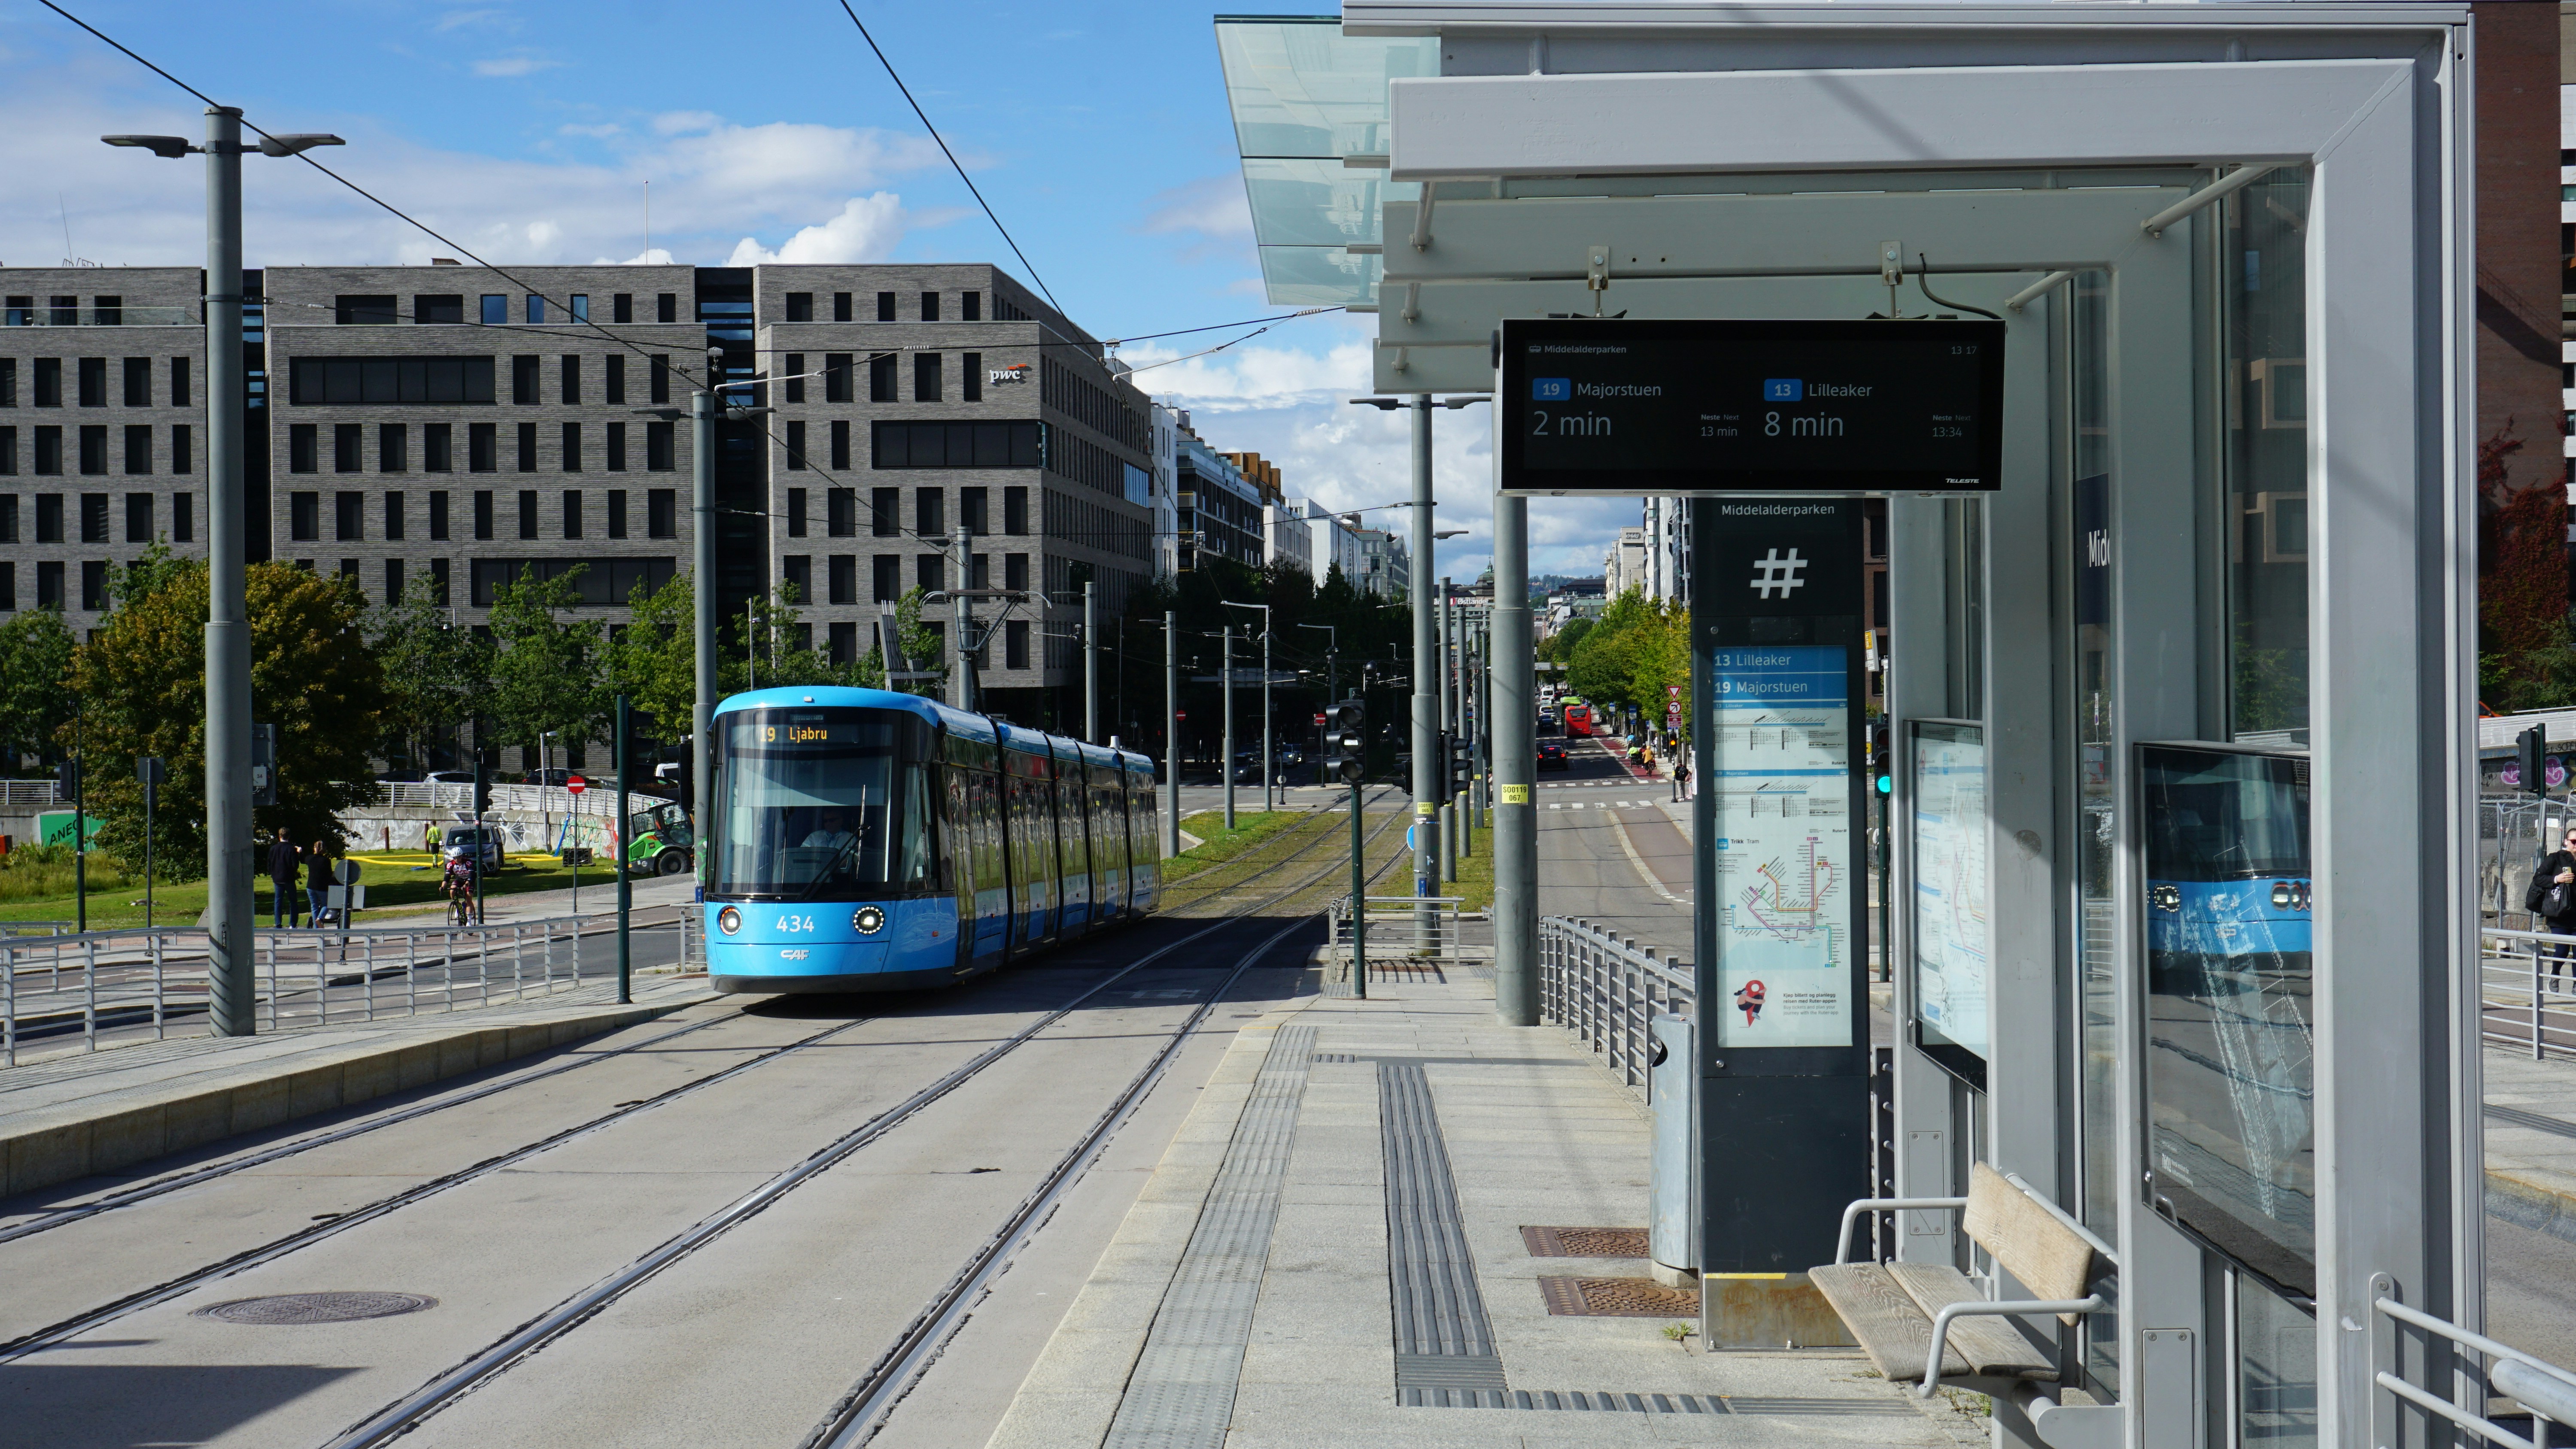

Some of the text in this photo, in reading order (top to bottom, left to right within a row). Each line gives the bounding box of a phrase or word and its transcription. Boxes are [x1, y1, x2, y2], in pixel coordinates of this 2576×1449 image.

[1544, 345, 1627, 355] Middelalderparken
[989, 369, 1021, 383] pwc
[1543, 383, 1662, 399] 19 Majorstuen
[1775, 384, 1873, 397] 13 Lilleaker
[1533, 411, 1611, 436] 2 min
[1765, 411, 1843, 436] 8 min
[1701, 426, 1738, 437] 13 min
[1932, 427, 1962, 437] 13:34
[1722, 504, 1835, 517] Middelalderparken
[1714, 654, 1791, 666] 13 Lilleaker
[1714, 681, 1808, 695] 19 Majorstuen
[760, 727, 827, 743] 19 Ljabru
[776, 915, 814, 932] 434
[781, 949, 810, 960] CAF
[2296, 1008, 2314, 1046] bolighus
